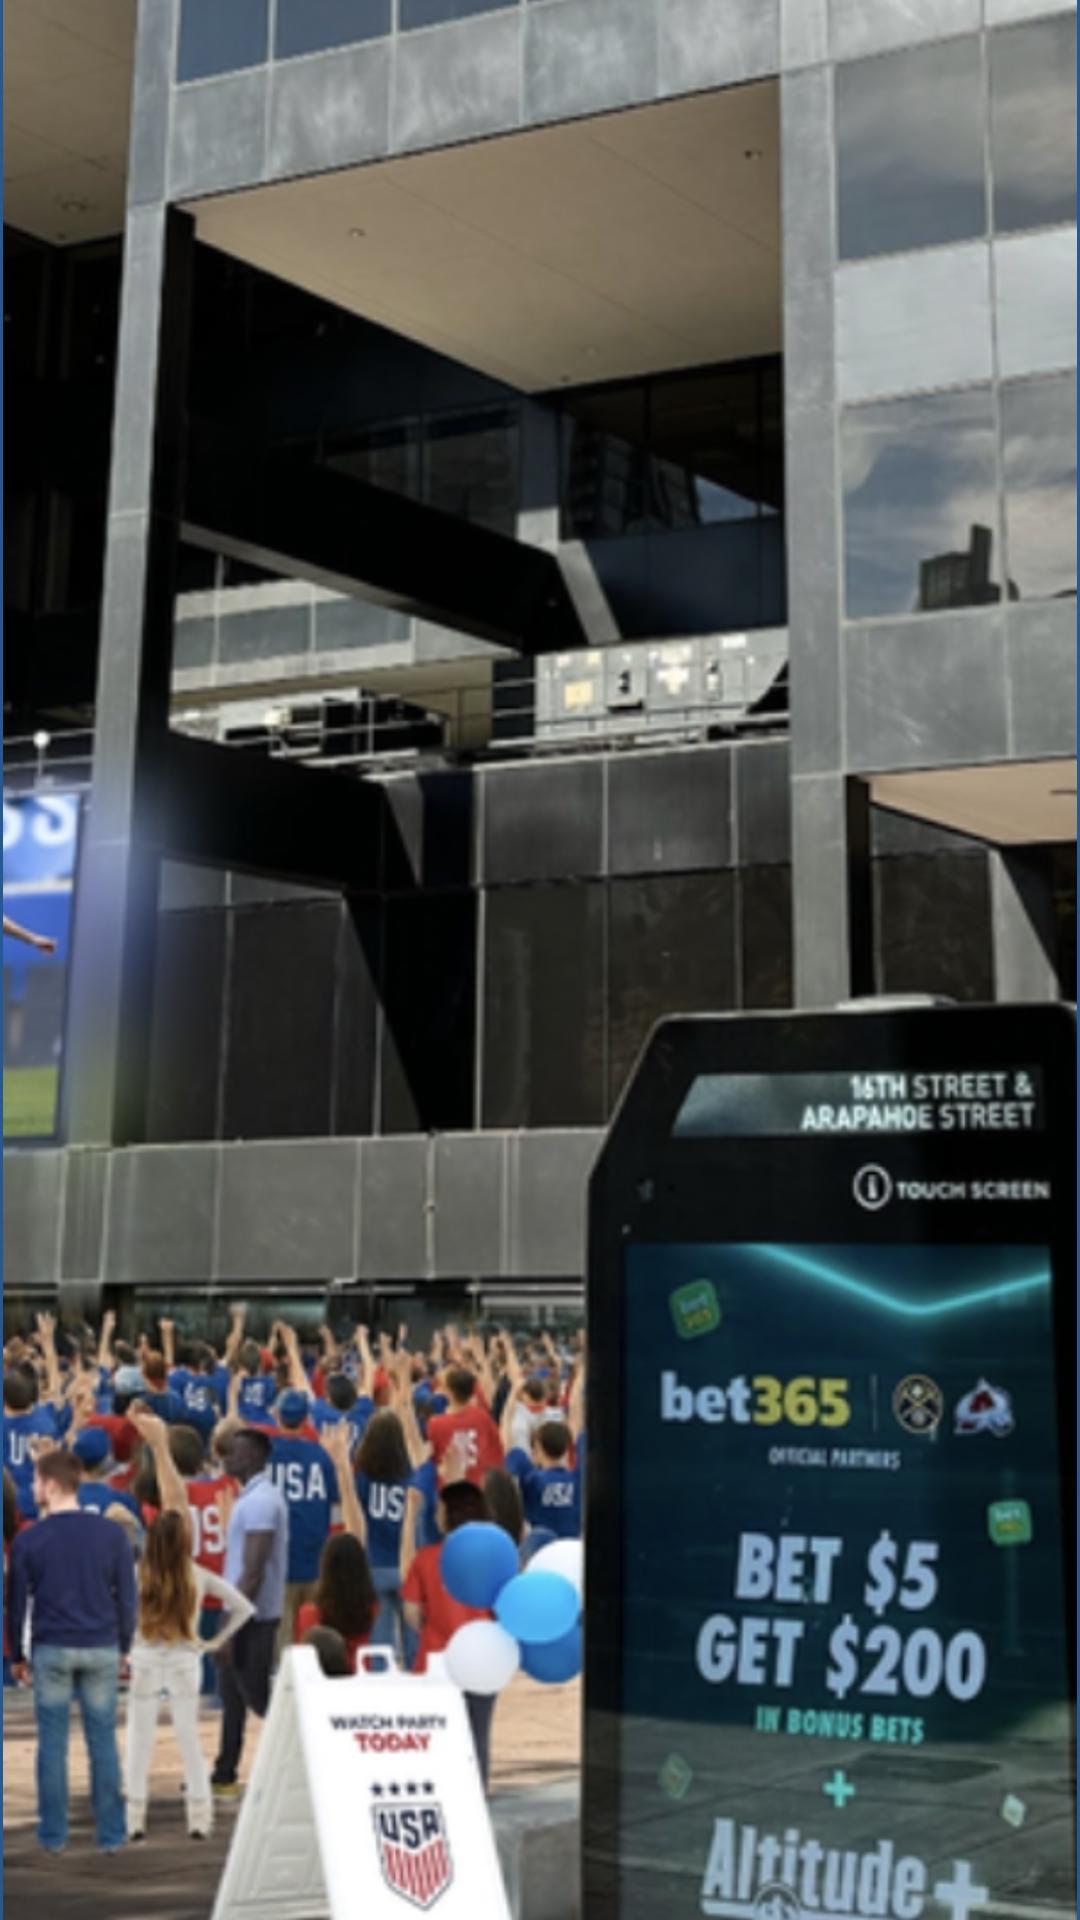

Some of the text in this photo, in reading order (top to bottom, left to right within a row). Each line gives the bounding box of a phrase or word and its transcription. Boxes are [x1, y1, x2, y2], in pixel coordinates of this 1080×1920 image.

[850, 1073, 1034, 1100] 16TH STREET &
[800, 1102, 1035, 1131] ARAPAHOE STREET
[896, 1181, 1050, 1200] TOUCH SCREEN
[660, 1370, 851, 1427] bet365
[735, 1529, 940, 1616] BET $5
[696, 1613, 987, 1701] GET $200
[329, 1714, 448, 1731] WATCH PARTY
[756, 1706, 925, 1745] IN BONUS BETS
[353, 1731, 432, 1752] TODAY
[380, 1808, 440, 1850] USA
